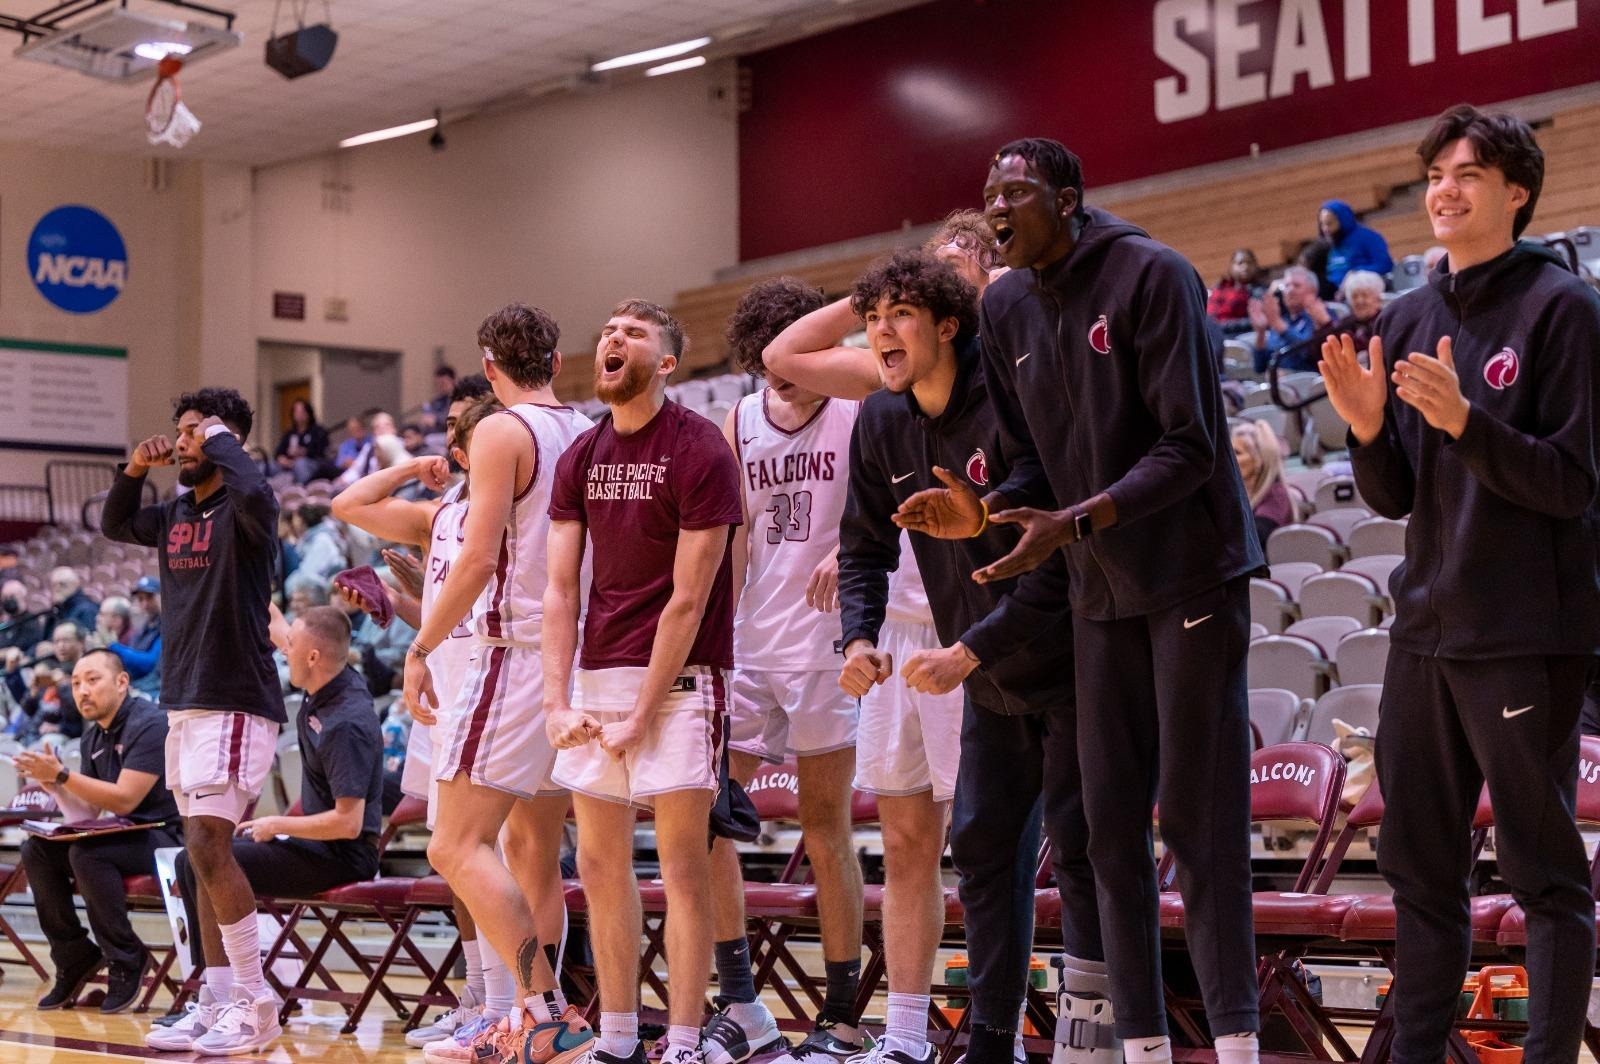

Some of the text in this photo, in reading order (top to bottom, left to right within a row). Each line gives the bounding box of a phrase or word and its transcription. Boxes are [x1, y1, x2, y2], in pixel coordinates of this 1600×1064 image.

[35, 253, 126, 289] NCAA
[587, 464, 666, 483] ATTLE PACIFIC
[747, 452, 835, 492] FALCONS
[587, 482, 653, 500] BASKETBALL
[766, 490, 812, 544] 33
[167, 520, 213, 553] SPU
[1250, 762, 1316, 787] ALCONS
[12, 790, 50, 809] FALCON
